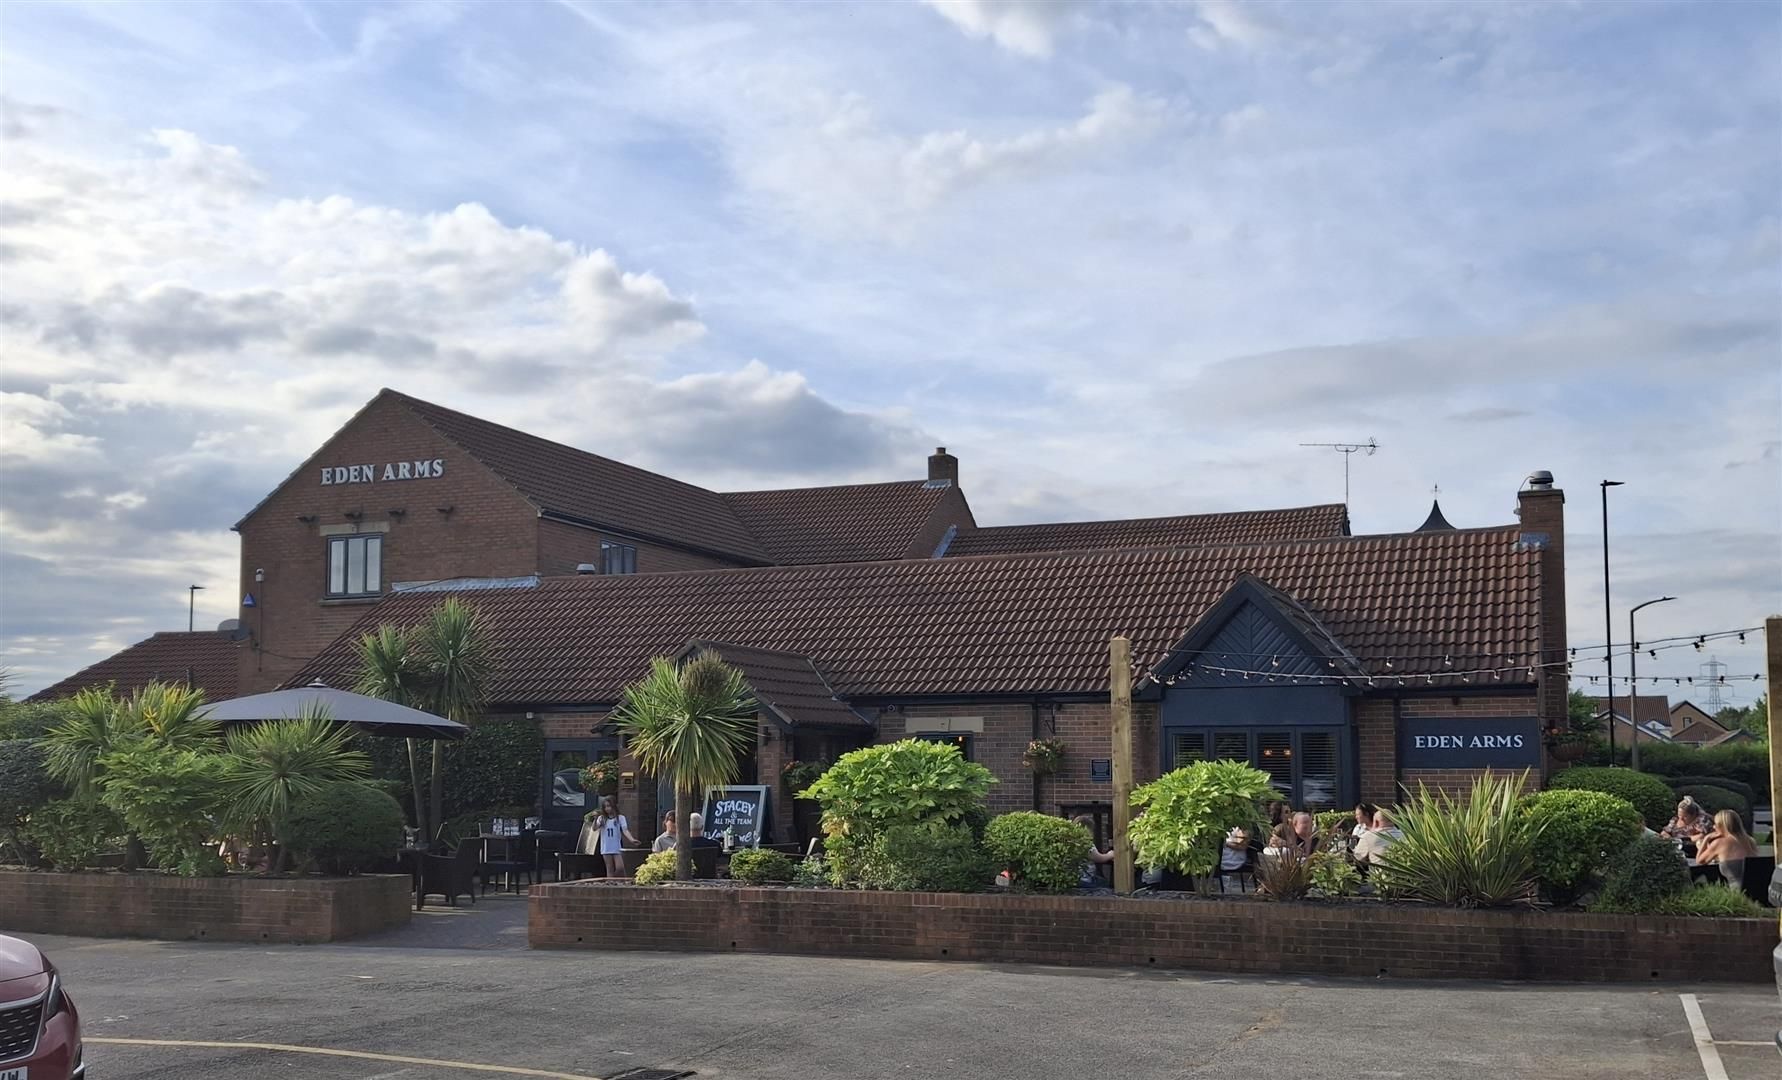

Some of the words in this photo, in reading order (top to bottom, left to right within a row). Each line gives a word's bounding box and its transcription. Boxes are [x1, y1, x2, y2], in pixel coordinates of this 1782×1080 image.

[320, 464, 375, 485] EDEN
[381, 459, 444, 480] ARMS
[1414, 735, 1463, 748] EDEN
[1469, 734, 1523, 748] ARMS
[715, 800, 755, 816] STACEY
[714, 817, 723, 825] ALL
[725, 817, 735, 825] THE
[607, 828, 614, 837] 11
